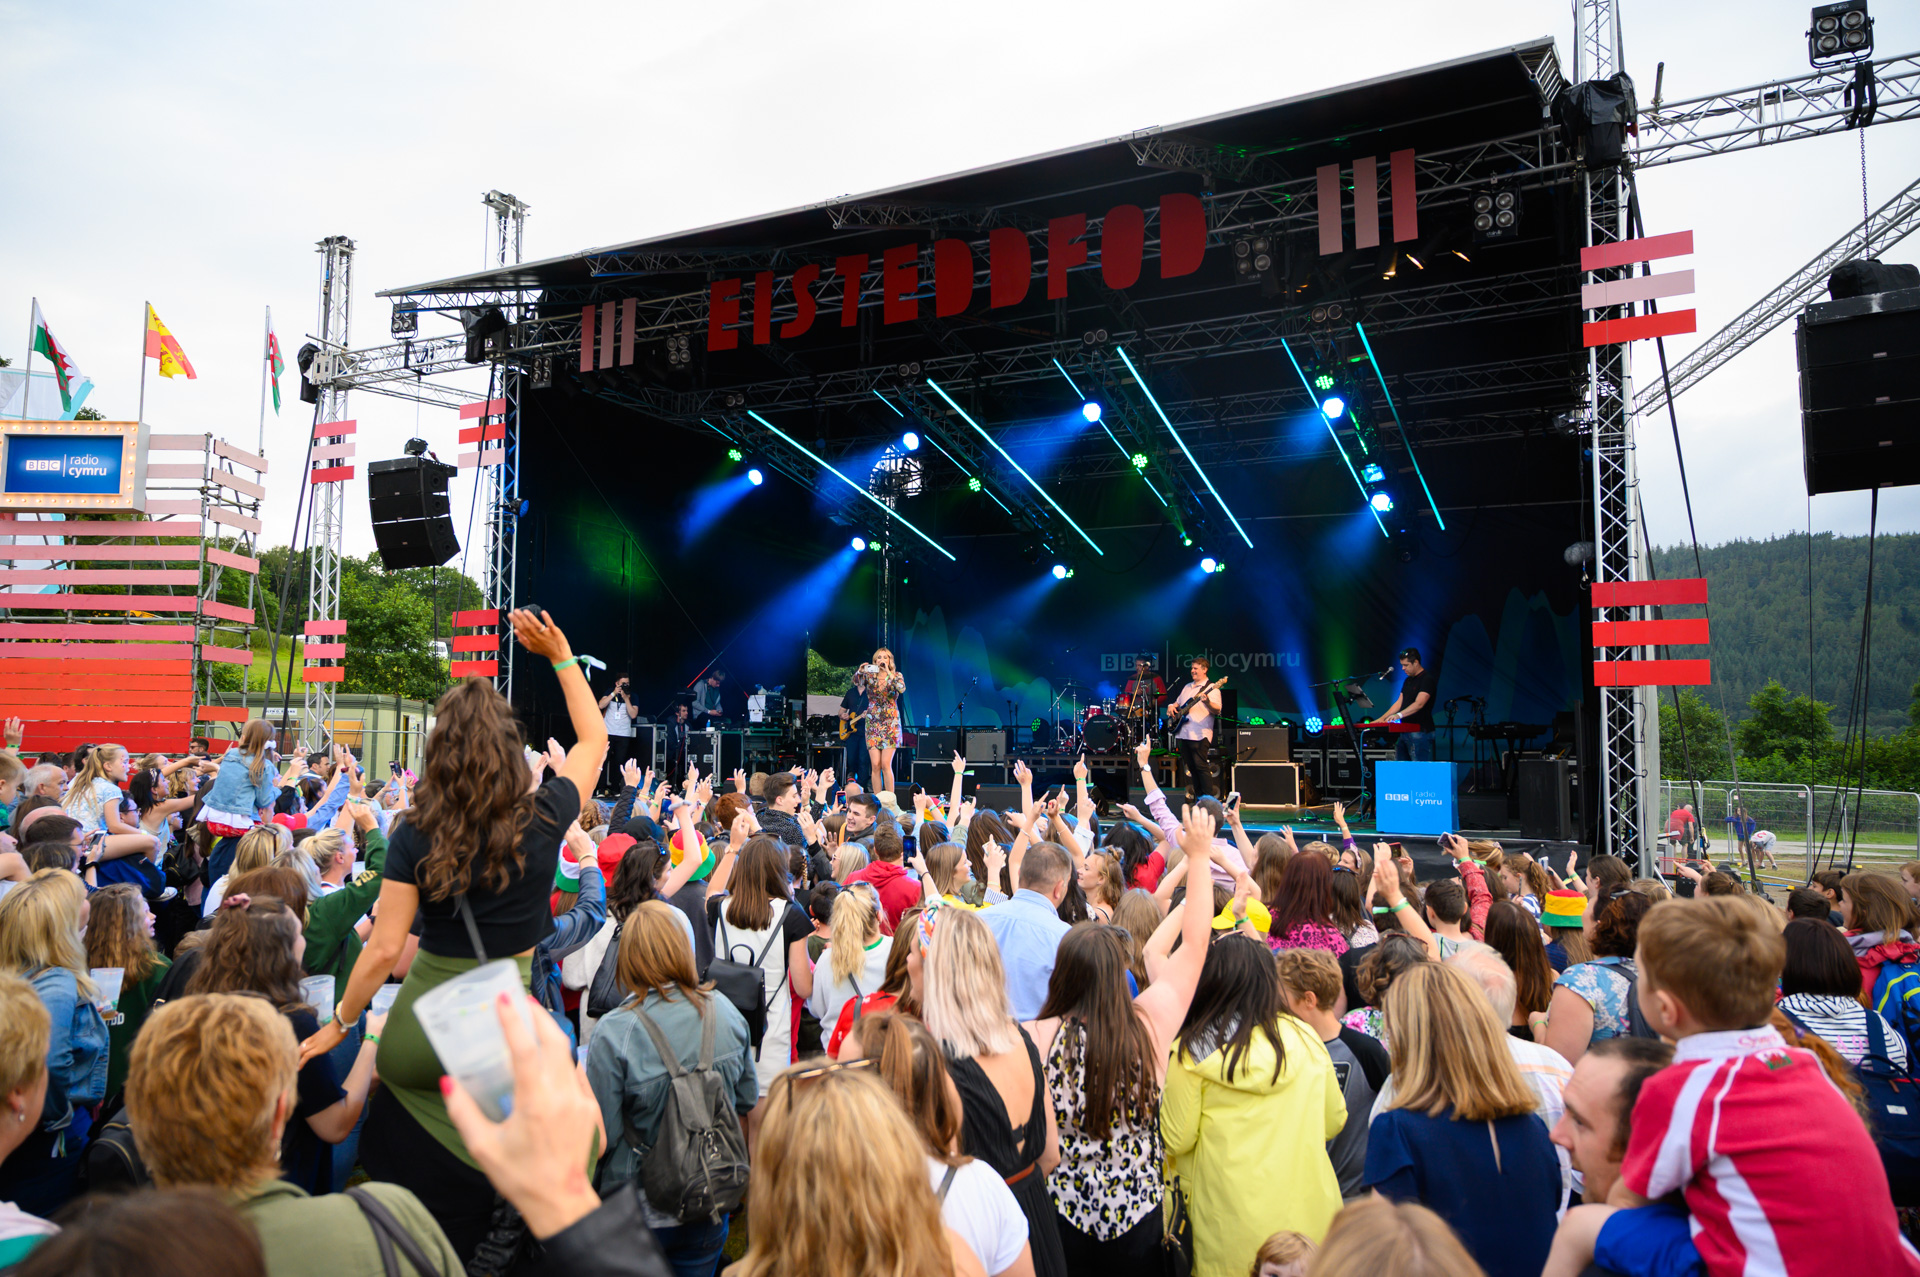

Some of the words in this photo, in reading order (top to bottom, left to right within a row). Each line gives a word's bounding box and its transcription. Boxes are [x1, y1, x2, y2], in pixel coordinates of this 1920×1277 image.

[707, 193, 1207, 352] EISTEDDFOD
[70, 454, 99, 465] radio
[26, 460, 60, 470] BBC
[69, 467, 107, 478] cymru
[1101, 653, 1159, 671] BB
[1385, 793, 1409, 801] BBC
[1415, 790, 1436, 798] radio
[1415, 798, 1442, 806] cymru
